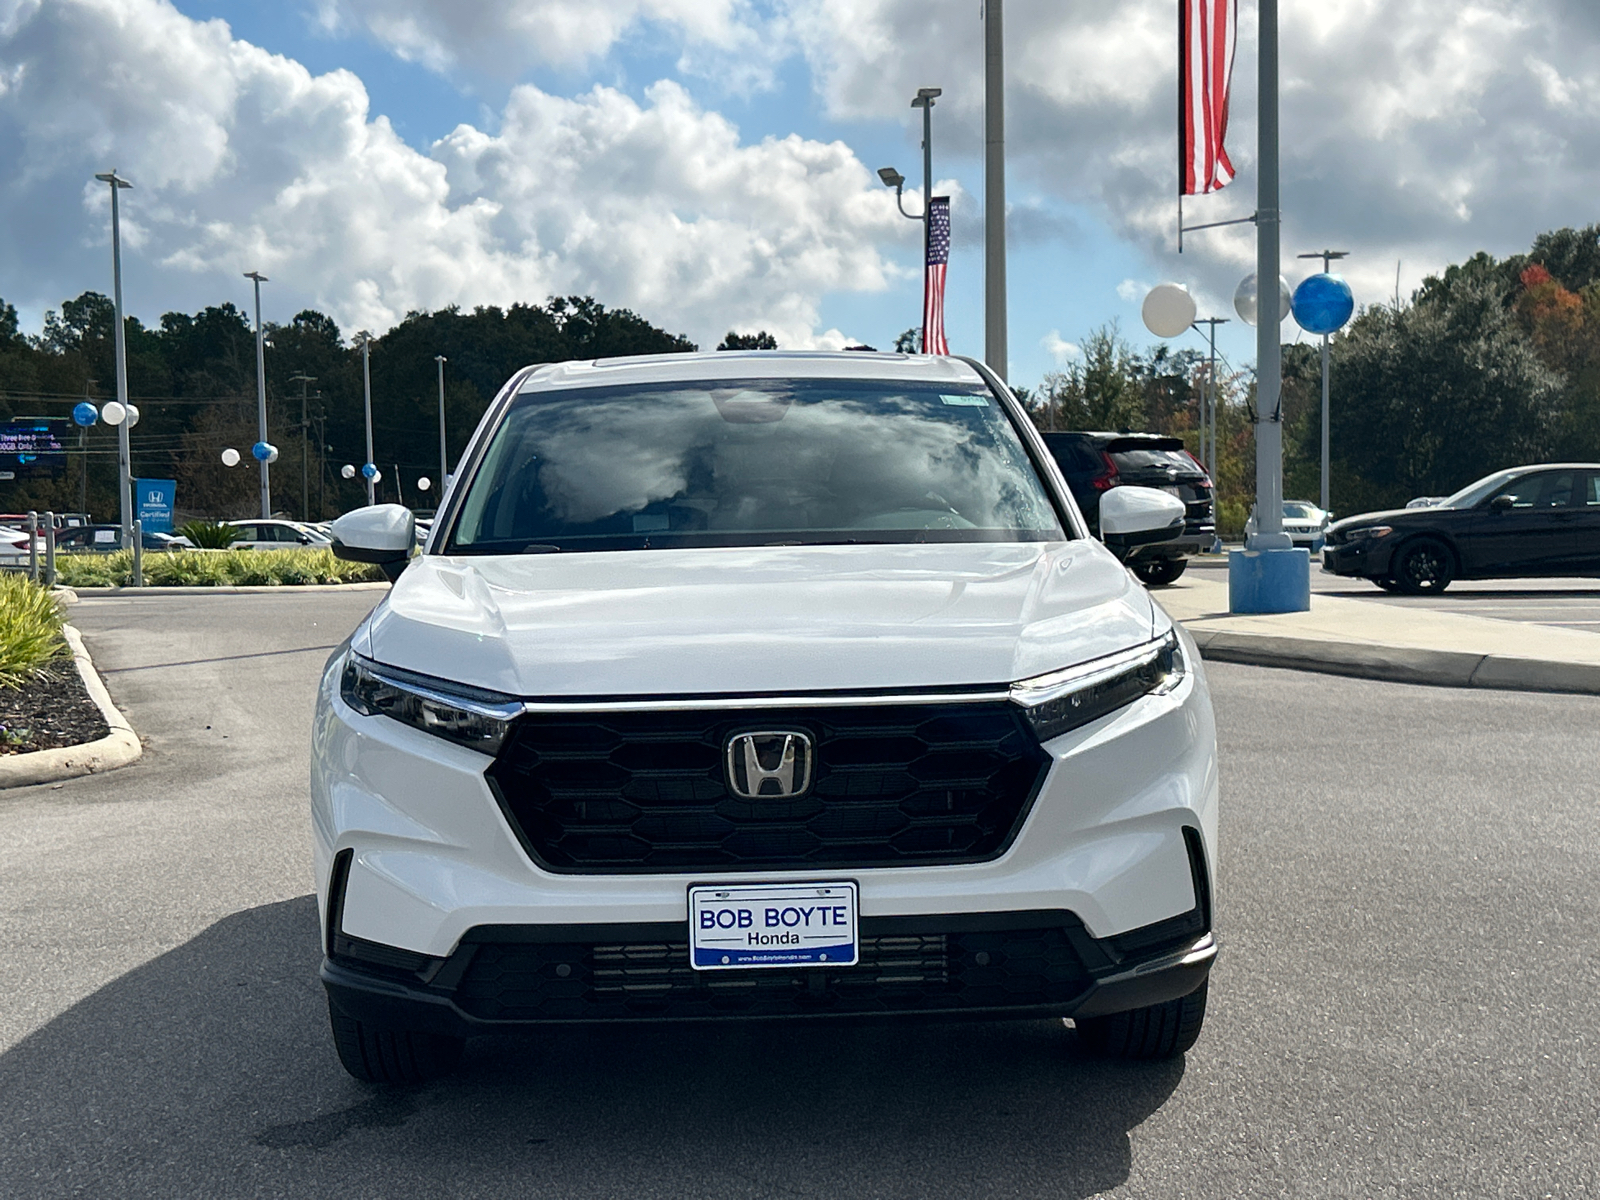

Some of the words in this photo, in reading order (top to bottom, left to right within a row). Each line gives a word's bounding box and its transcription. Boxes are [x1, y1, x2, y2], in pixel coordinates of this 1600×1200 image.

[700, 909, 753, 929] BOB
[765, 906, 848, 927] BOYTE
[748, 931, 800, 945] Honda
